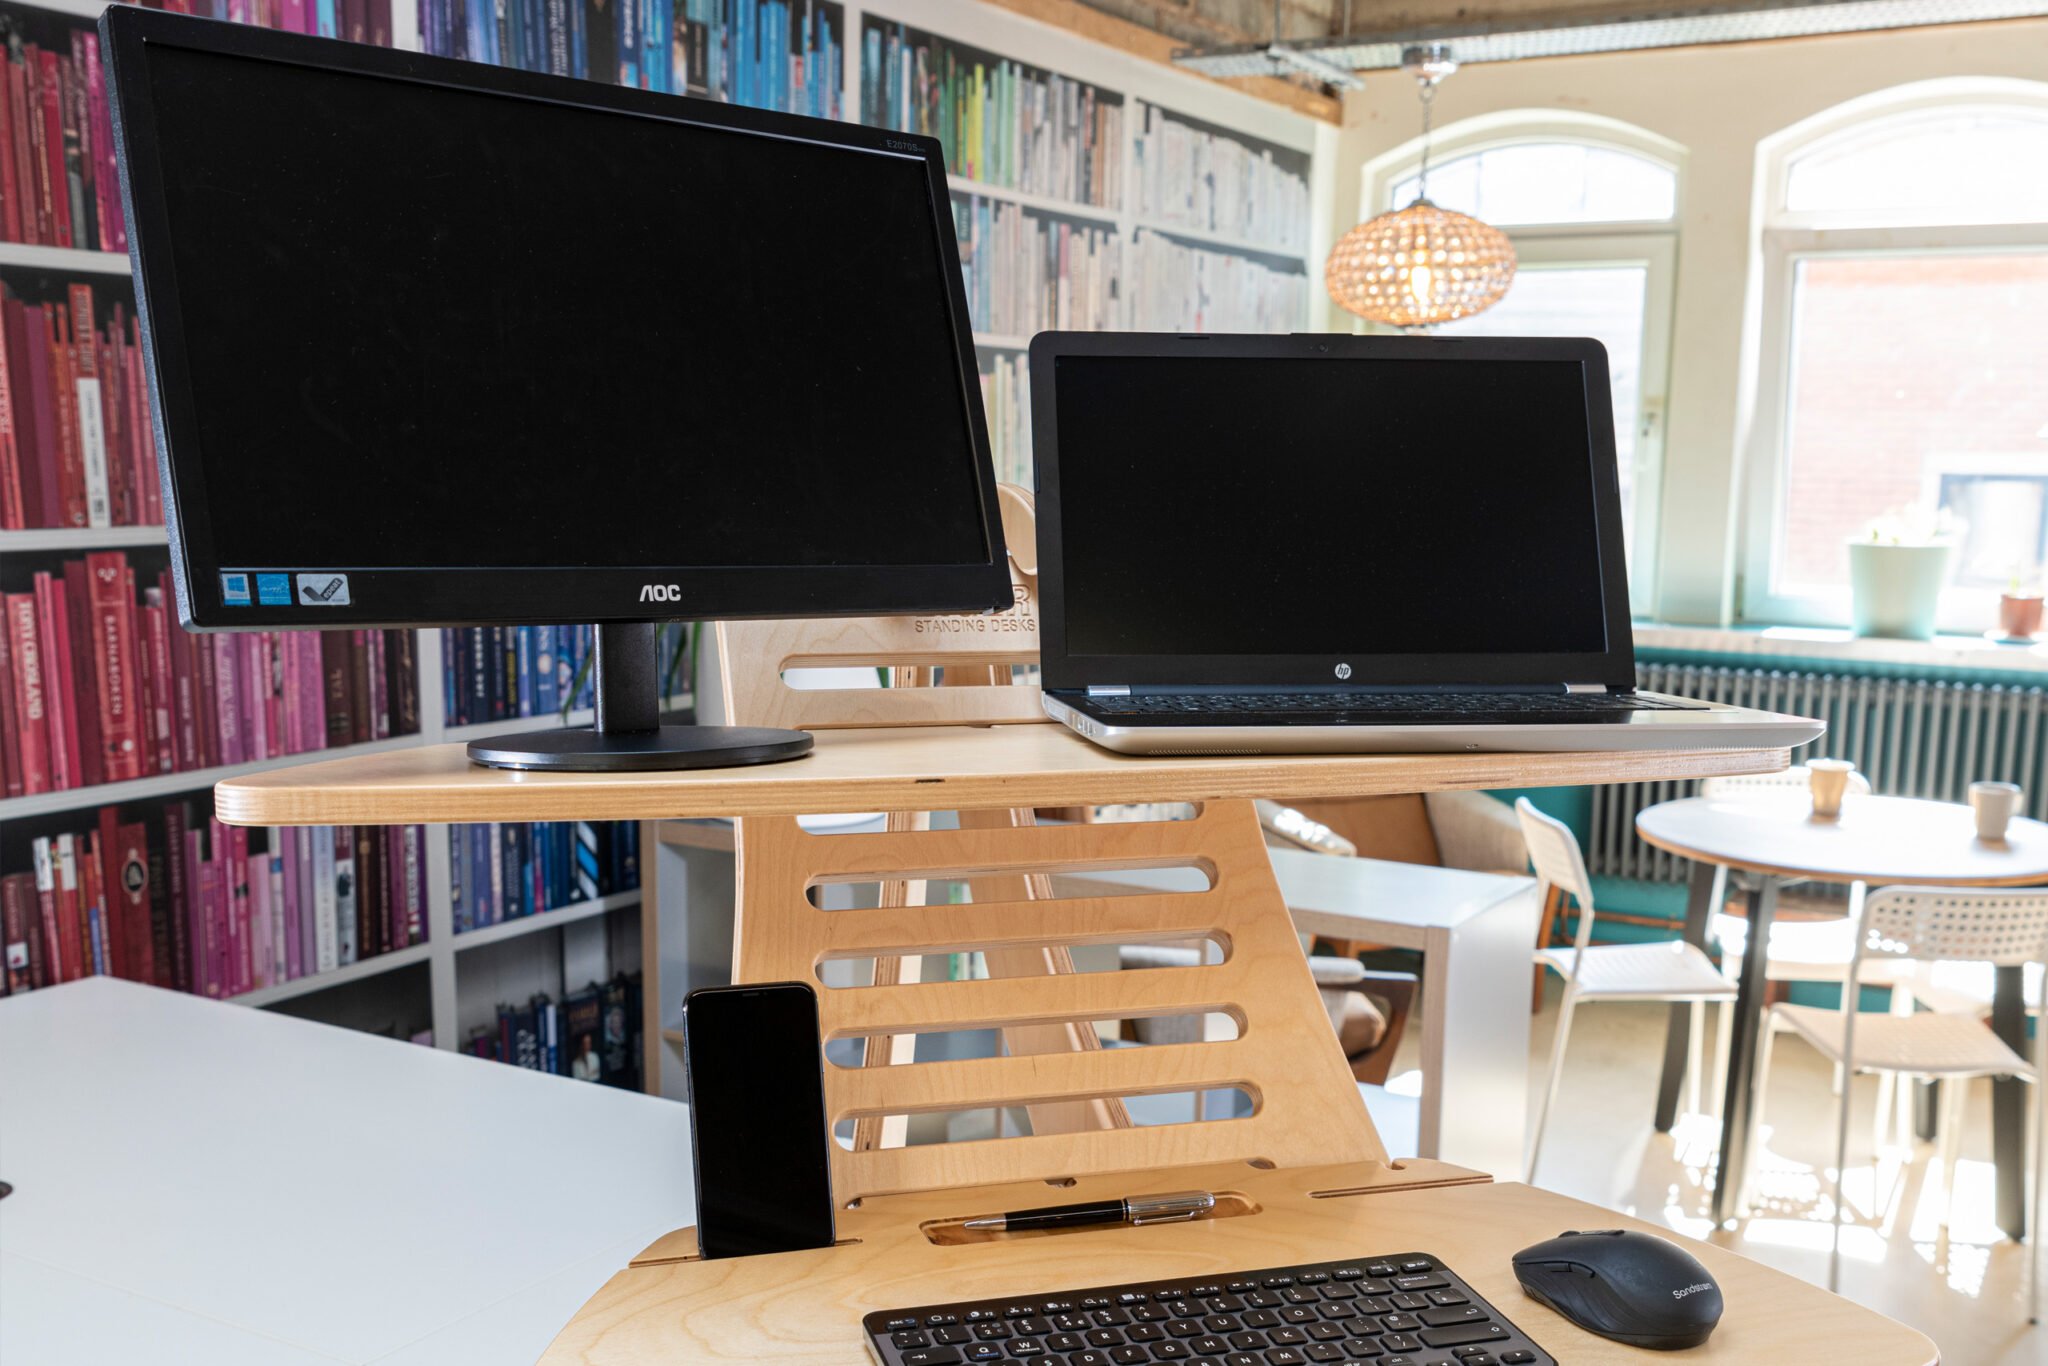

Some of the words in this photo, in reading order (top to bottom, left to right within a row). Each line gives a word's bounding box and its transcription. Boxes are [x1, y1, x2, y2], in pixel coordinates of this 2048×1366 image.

[323, 579, 340, 599] epeat
[639, 584, 681, 602] AOC
[915, 619, 986, 633] STANDING
[990, 618, 1036, 632] DESKS
[1336, 663, 1350, 679] hp
[1018, 1341, 1031, 1349] W
[1203, 1340, 1216, 1348] H
[1084, 1354, 1094, 1362] D
[1240, 1356, 1252, 1364] N
[1280, 1352, 1293, 1360] M
